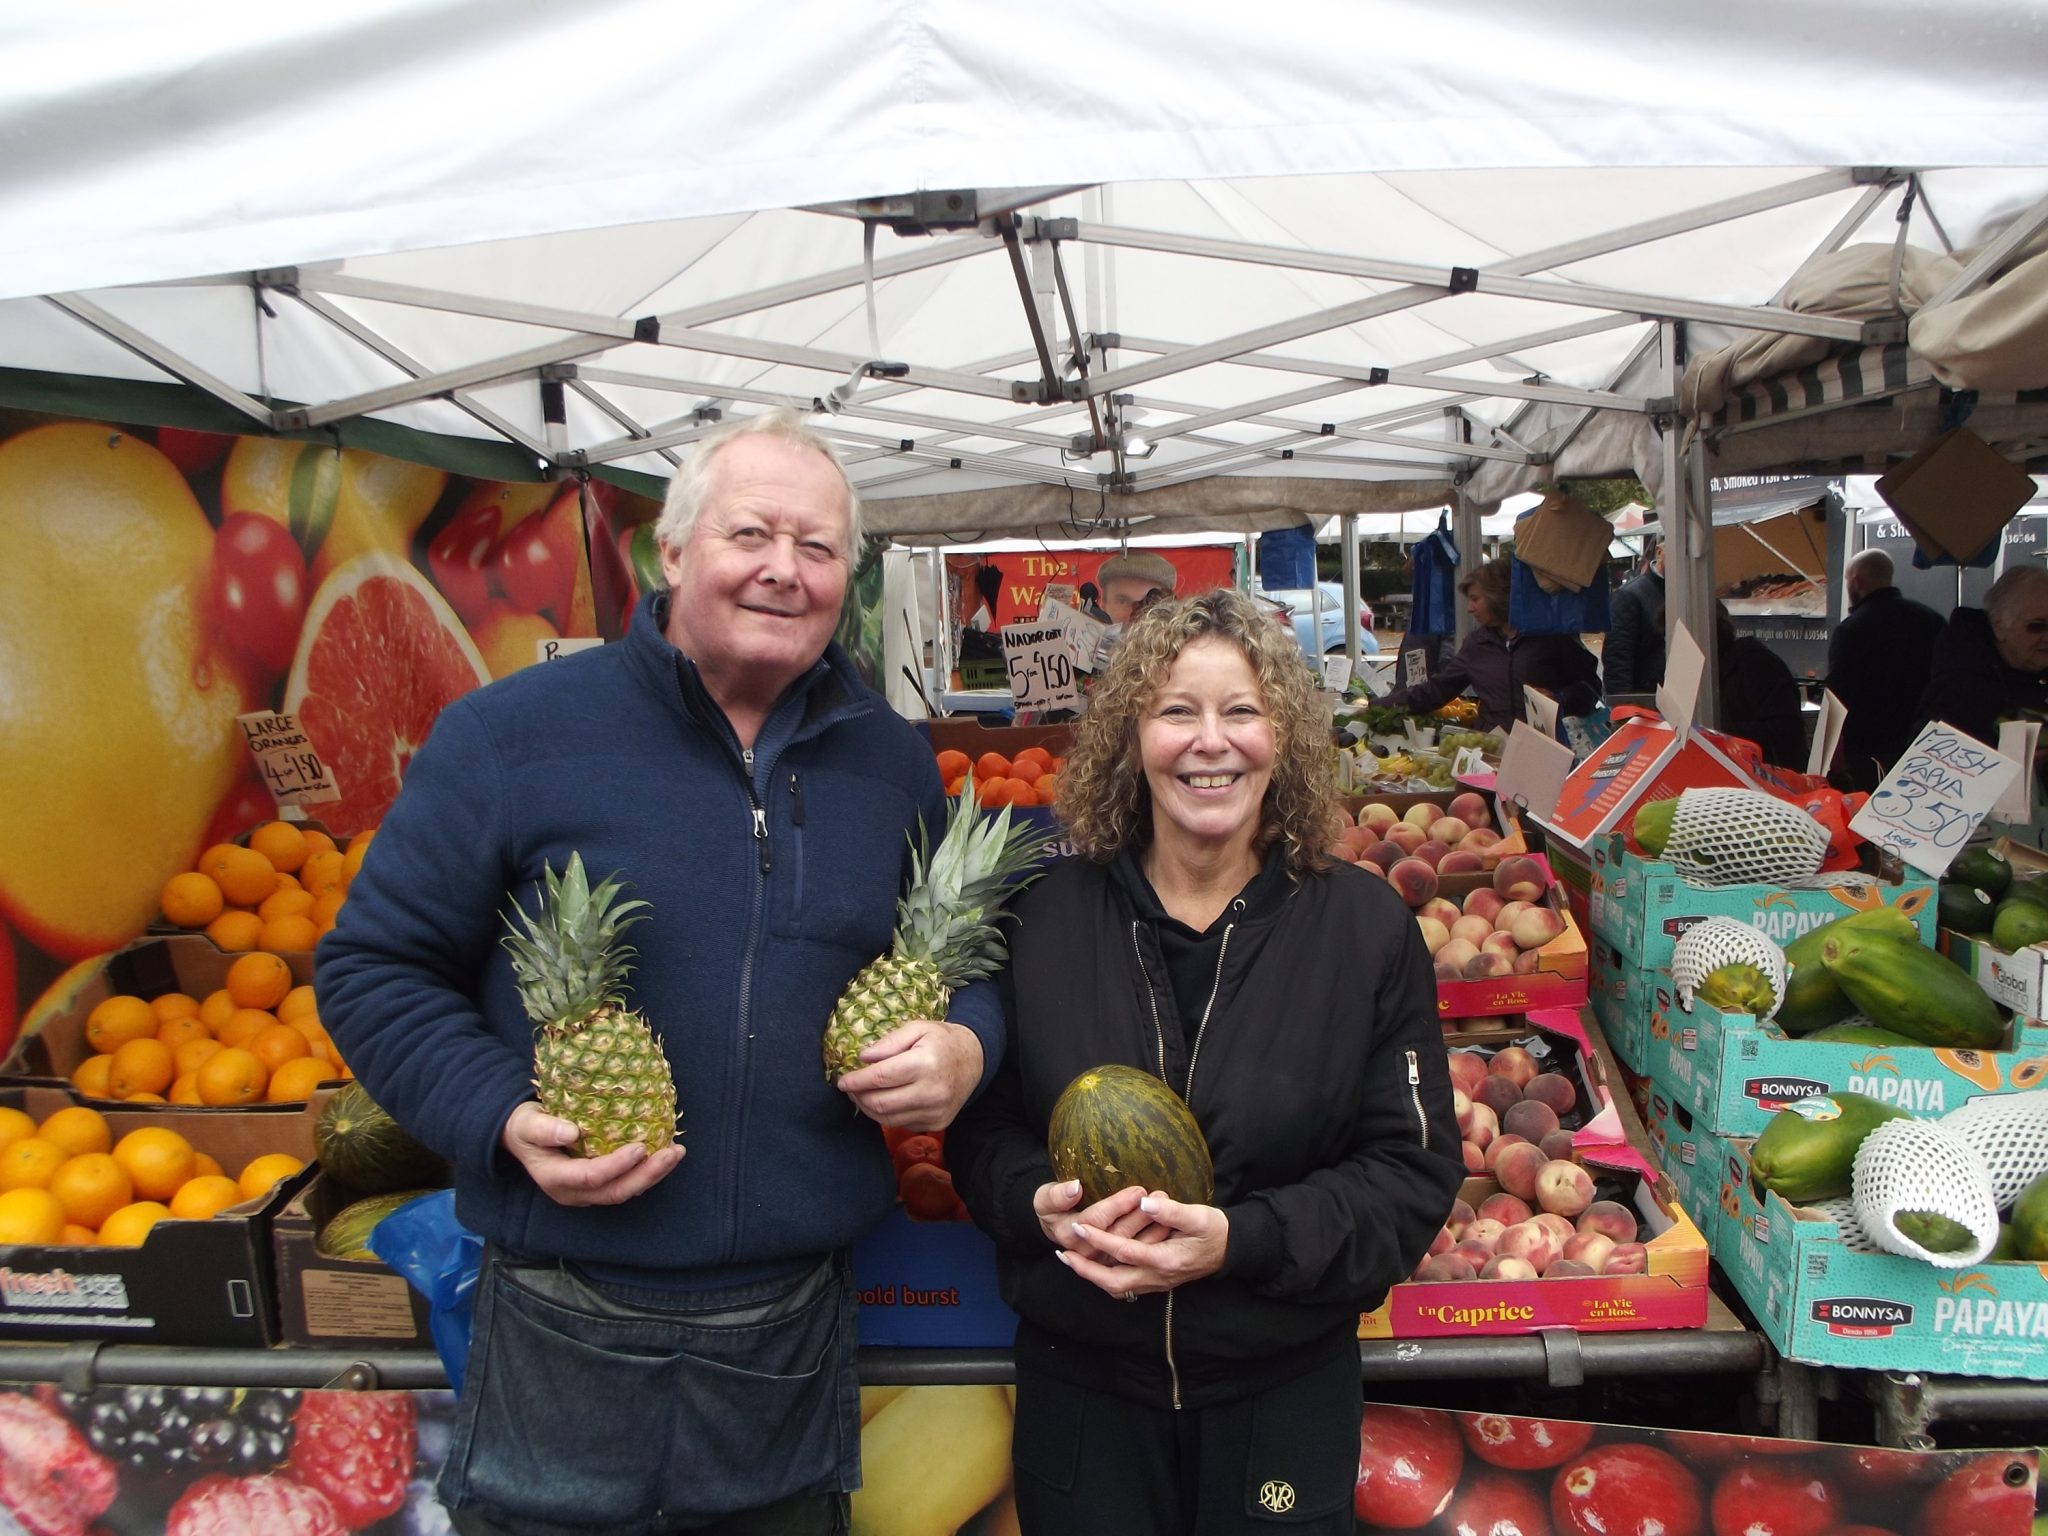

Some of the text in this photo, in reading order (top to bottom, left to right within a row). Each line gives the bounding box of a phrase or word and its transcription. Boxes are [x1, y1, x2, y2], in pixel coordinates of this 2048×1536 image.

[1876, 525, 1887, 538] &
[1022, 557, 1068, 577] The
[1009, 655, 1029, 698] 5
[242, 716, 295, 739] LARGE
[264, 759, 284, 788] 4
[1752, 911, 1836, 940] PAPAY
[1761, 1083, 1822, 1097] BONNYSA
[1848, 1076, 1944, 1112] PAPAYA
[902, 1286, 960, 1305] burst
[1594, 1298, 1633, 1309] La Vie
[1437, 1301, 1535, 1327] Caprice
[1590, 1307, 1637, 1317] en Rose
[1832, 1305, 1905, 1321] BONNYSA
[1934, 1296, 2048, 1339] PAPAYA
